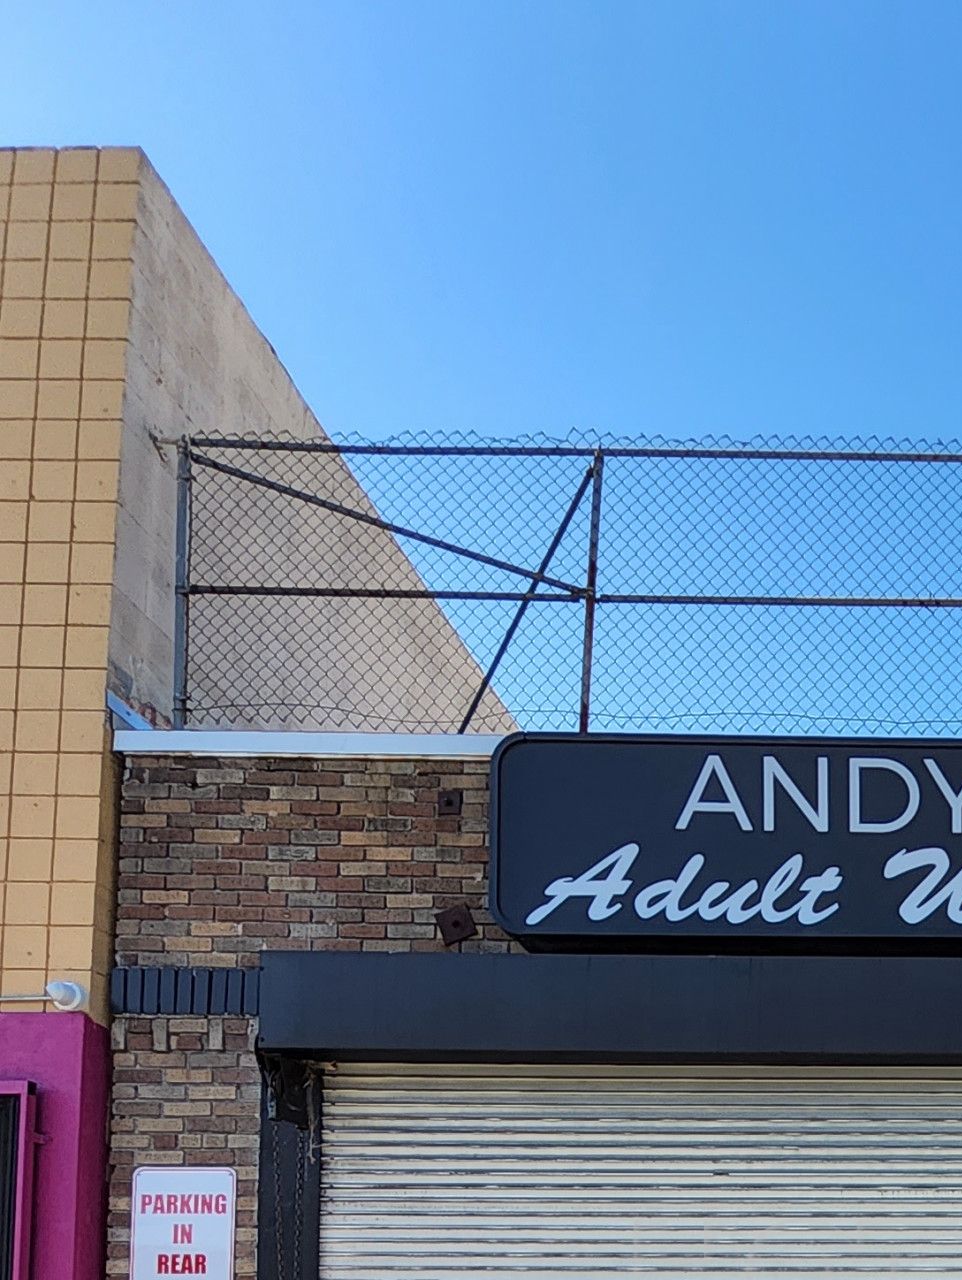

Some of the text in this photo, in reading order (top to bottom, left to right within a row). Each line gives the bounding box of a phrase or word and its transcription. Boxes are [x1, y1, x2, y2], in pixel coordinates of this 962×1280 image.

[526, 844, 842, 924] Adult
[141, 1194, 226, 1214] PARKING
[173, 1224, 192, 1244] IN
[157, 1254, 206, 1274] REAR
